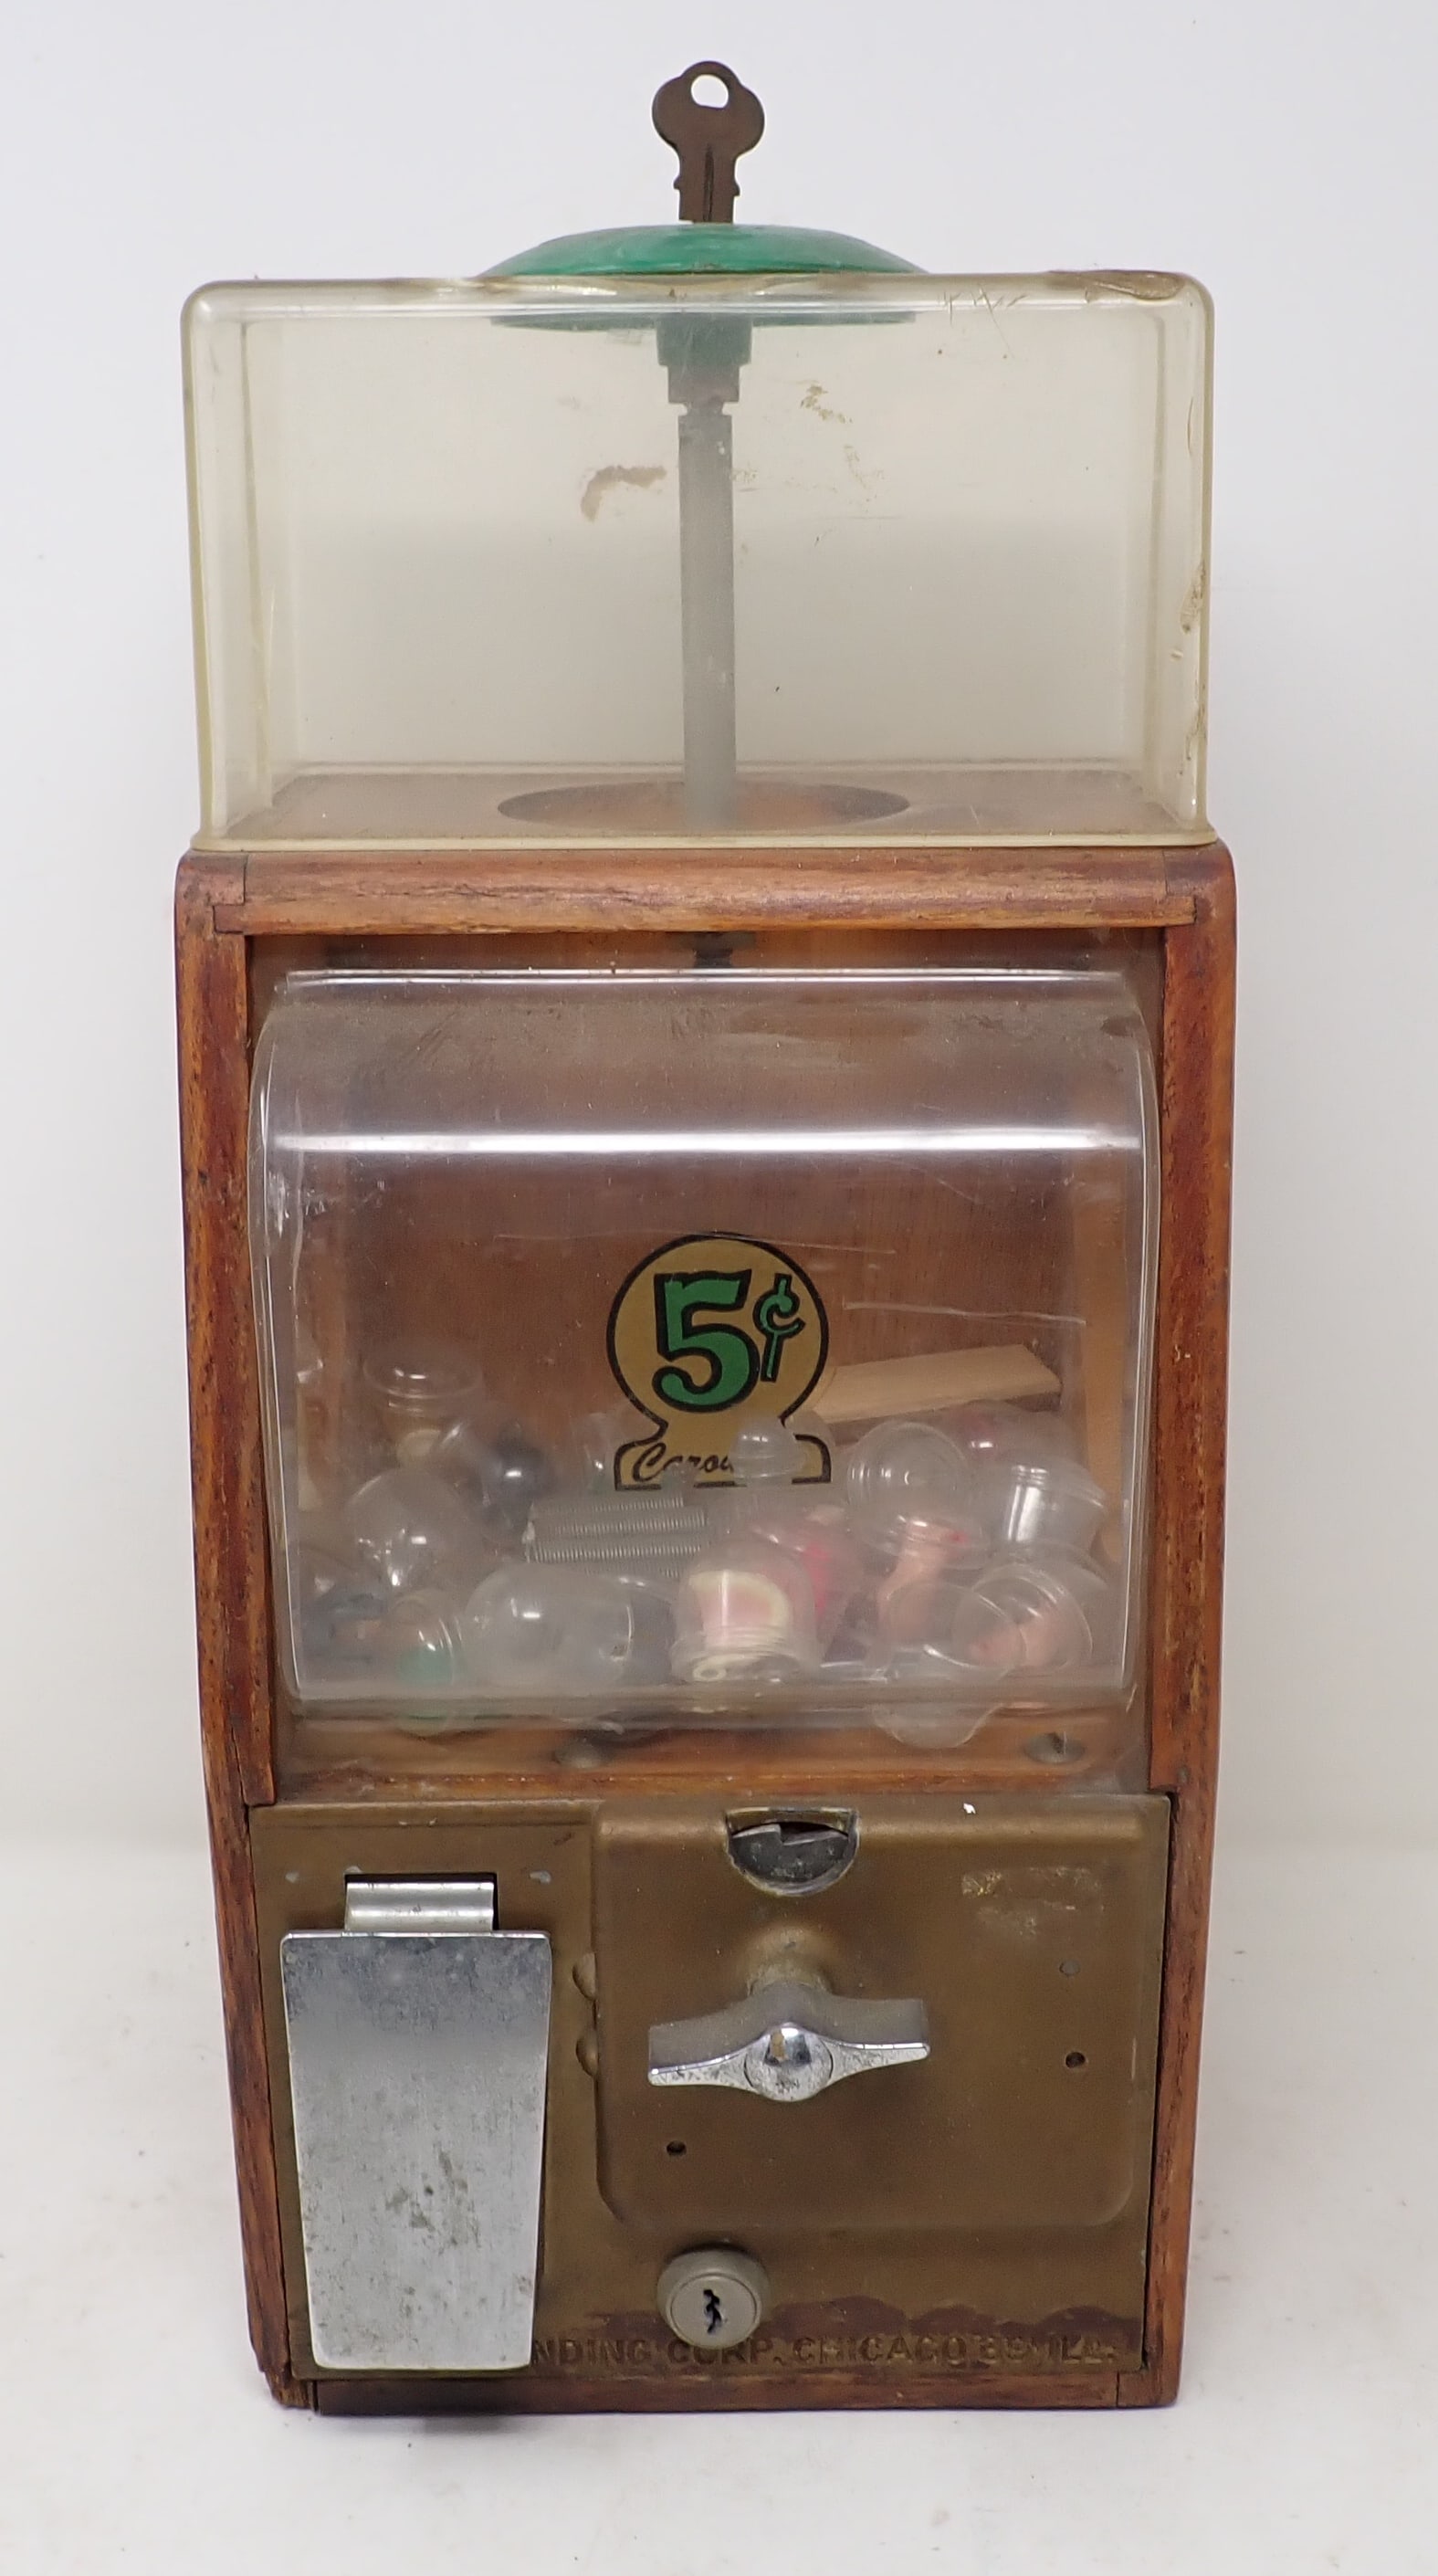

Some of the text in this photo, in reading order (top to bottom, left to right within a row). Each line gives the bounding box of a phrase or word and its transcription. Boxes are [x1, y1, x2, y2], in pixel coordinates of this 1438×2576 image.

[652, 1269, 805, 1413] 5¢
[531, 2338, 653, 2365] NDING
[792, 2336, 968, 2368] CHICAGO
